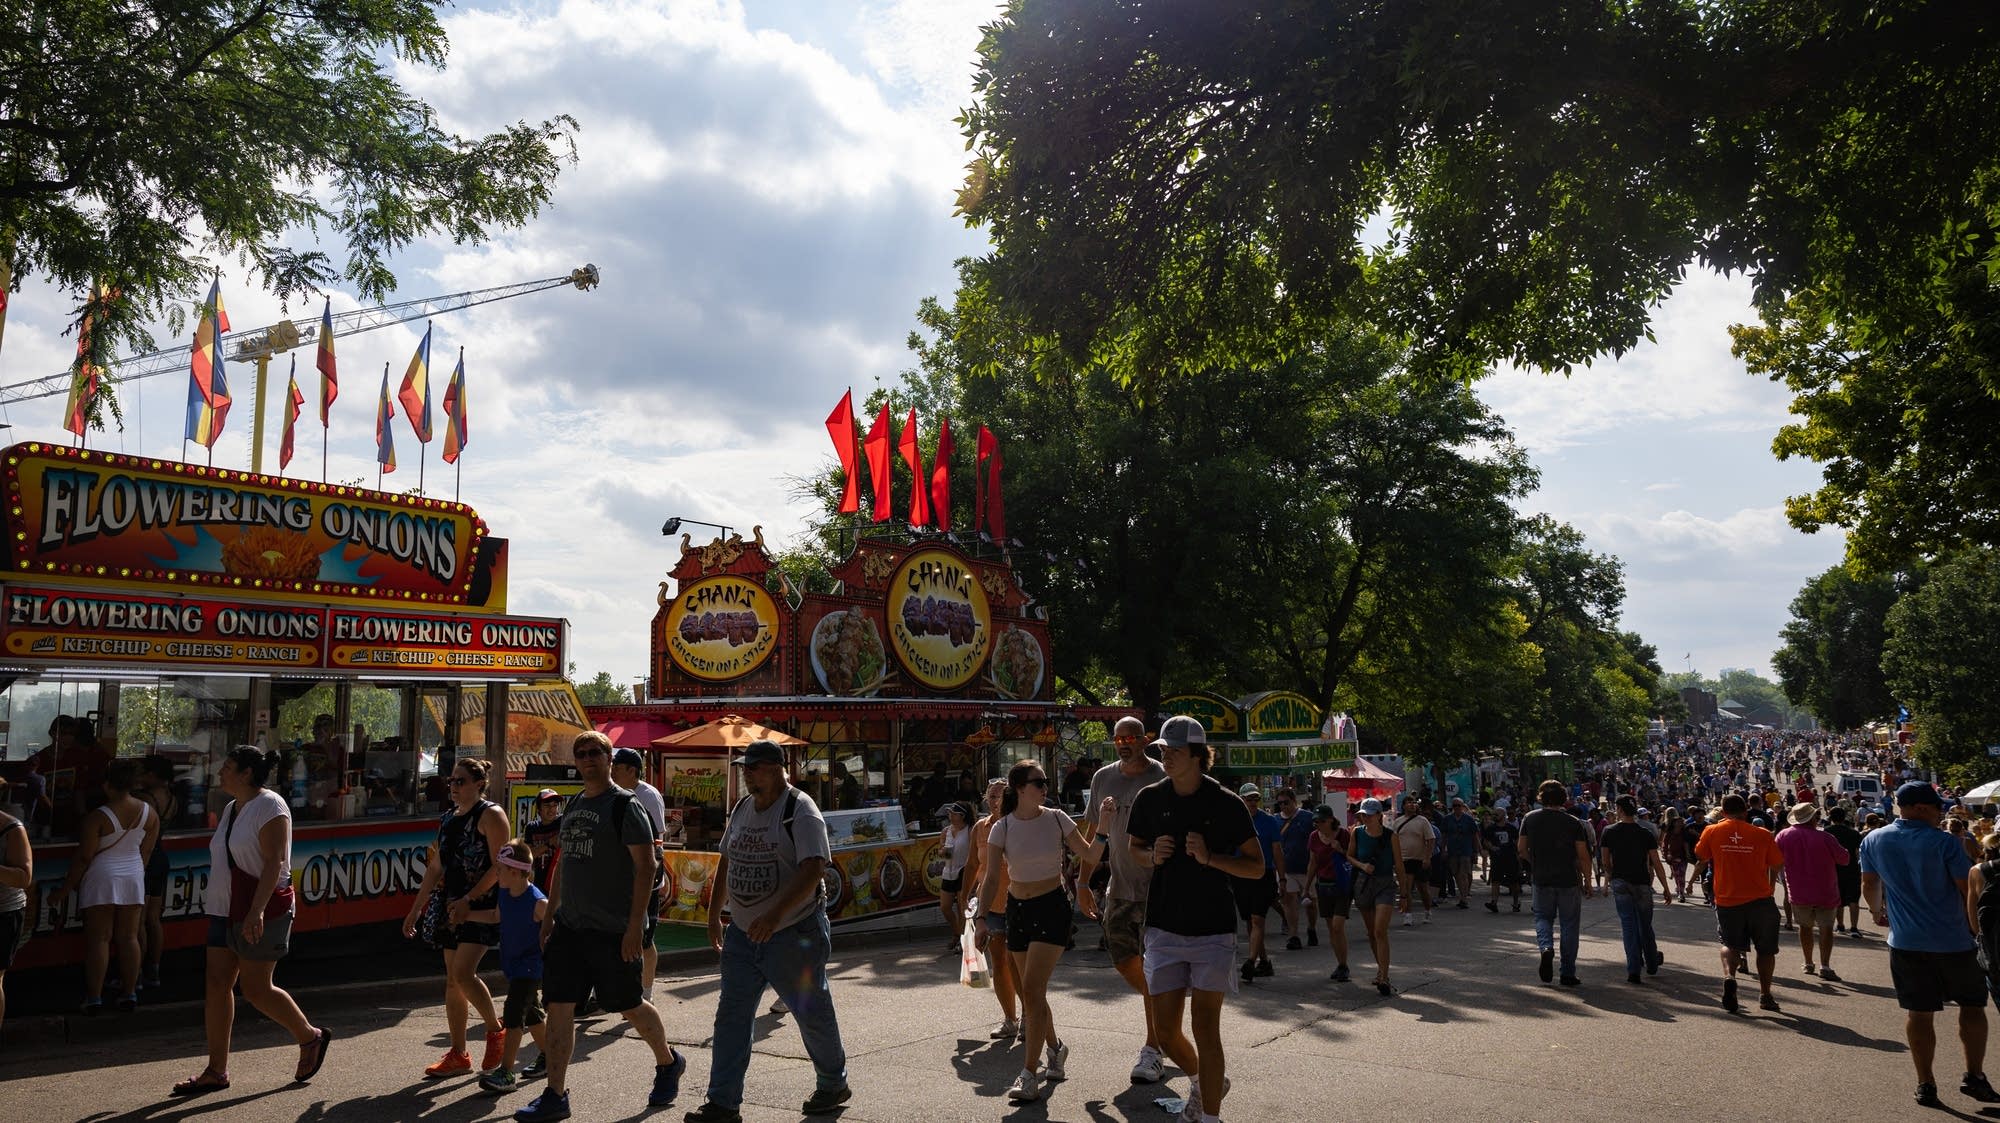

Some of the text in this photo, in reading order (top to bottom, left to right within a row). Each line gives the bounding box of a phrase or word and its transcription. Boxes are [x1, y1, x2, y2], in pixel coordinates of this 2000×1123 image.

[39, 467, 457, 583] FLOWERING ONIONS
[907, 561, 971, 599] CHAN'S
[685, 584, 755, 612] CHAN'S
[10, 594, 321, 640] FLOWERING ONIONS
[334, 615, 558, 649] FLOWERING ONIONS
[32, 636, 301, 661] with KETCHUP CHEESE RANCH
[372, 650, 435, 665] KETCHUP
[446, 652, 495, 666] CHEESE
[504, 655, 544, 667] RANCH
[671, 636, 714, 673] CHICKEN
[716, 659, 731, 672] ON
[743, 631, 773, 667] STICK
[895, 623, 938, 678] CHICKEN
[940, 663, 953, 679] ON
[963, 632, 986, 673] STICK
[575, 838, 594, 857] FAIR
[742, 833, 764, 844] TALK
[303, 847, 428, 903] ONIONS
[732, 878, 773, 893] DVICE
